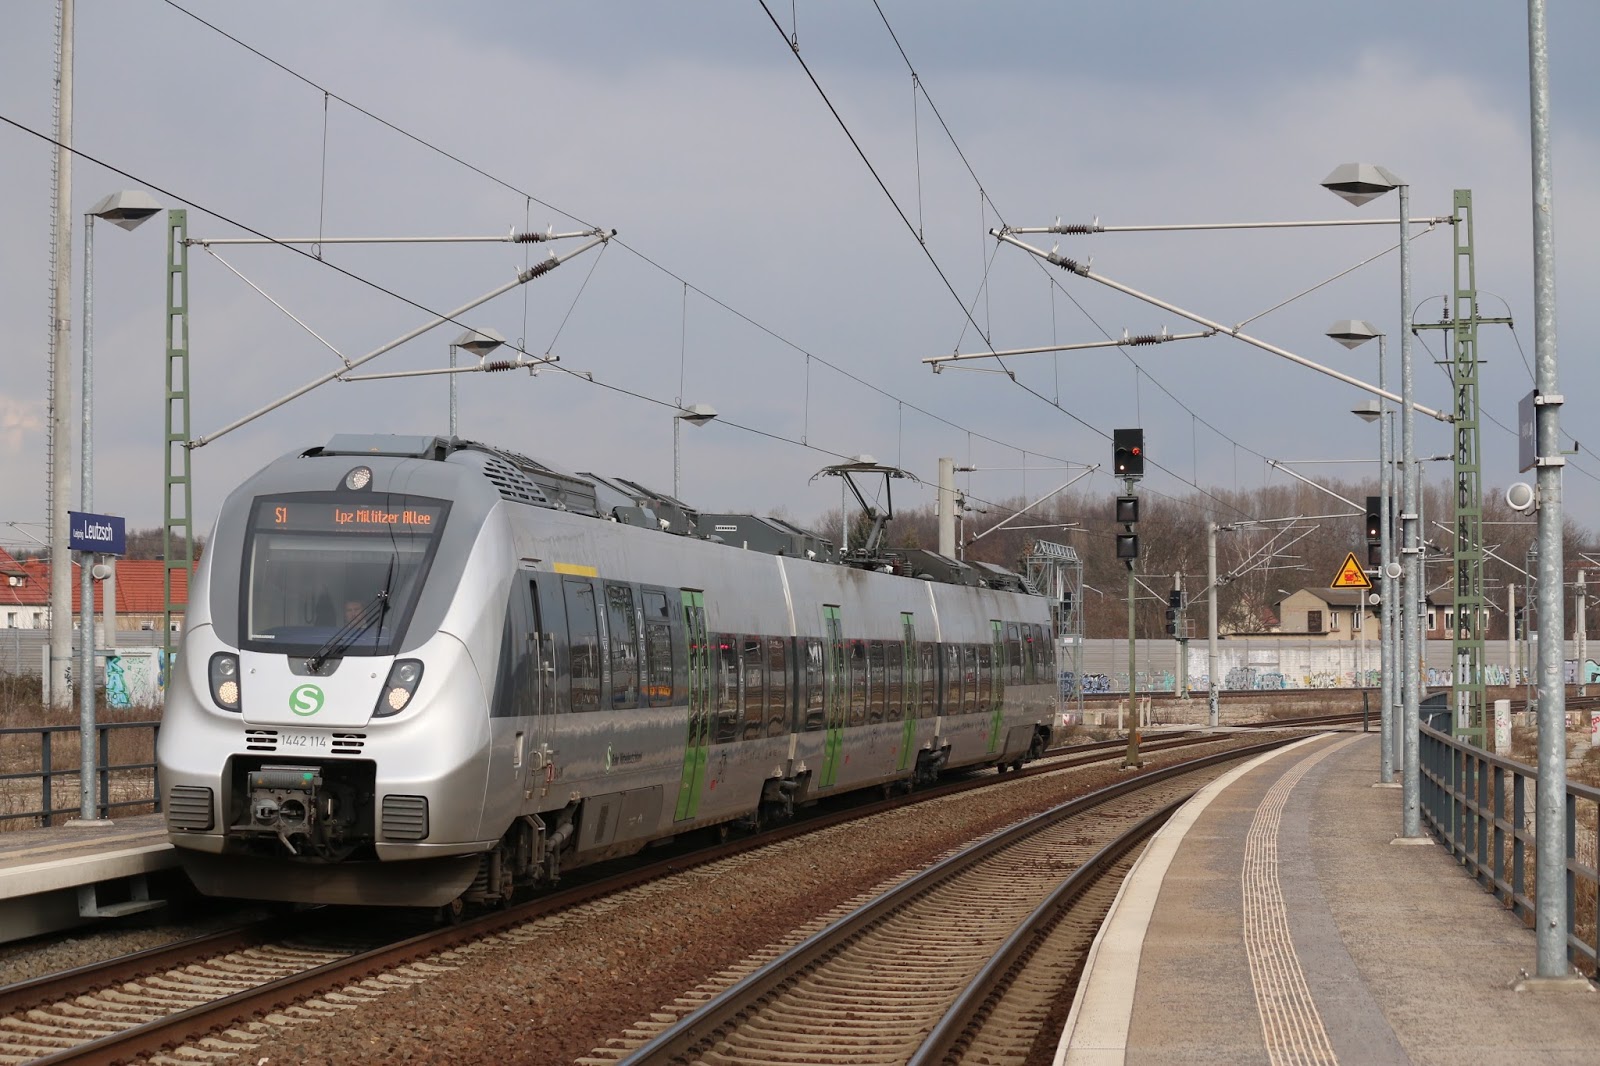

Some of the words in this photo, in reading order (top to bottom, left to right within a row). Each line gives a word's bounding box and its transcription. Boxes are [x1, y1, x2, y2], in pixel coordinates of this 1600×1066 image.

[275, 507, 287, 523] S1
[335, 509, 353, 523] Lpz
[356, 509, 400, 524] Miltitzer
[402, 510, 431, 525] Allee
[84, 519, 113, 542] Leutzsch
[293, 686, 320, 714] S
[281, 734, 306, 747] 1442
[310, 735, 327, 748] 114
